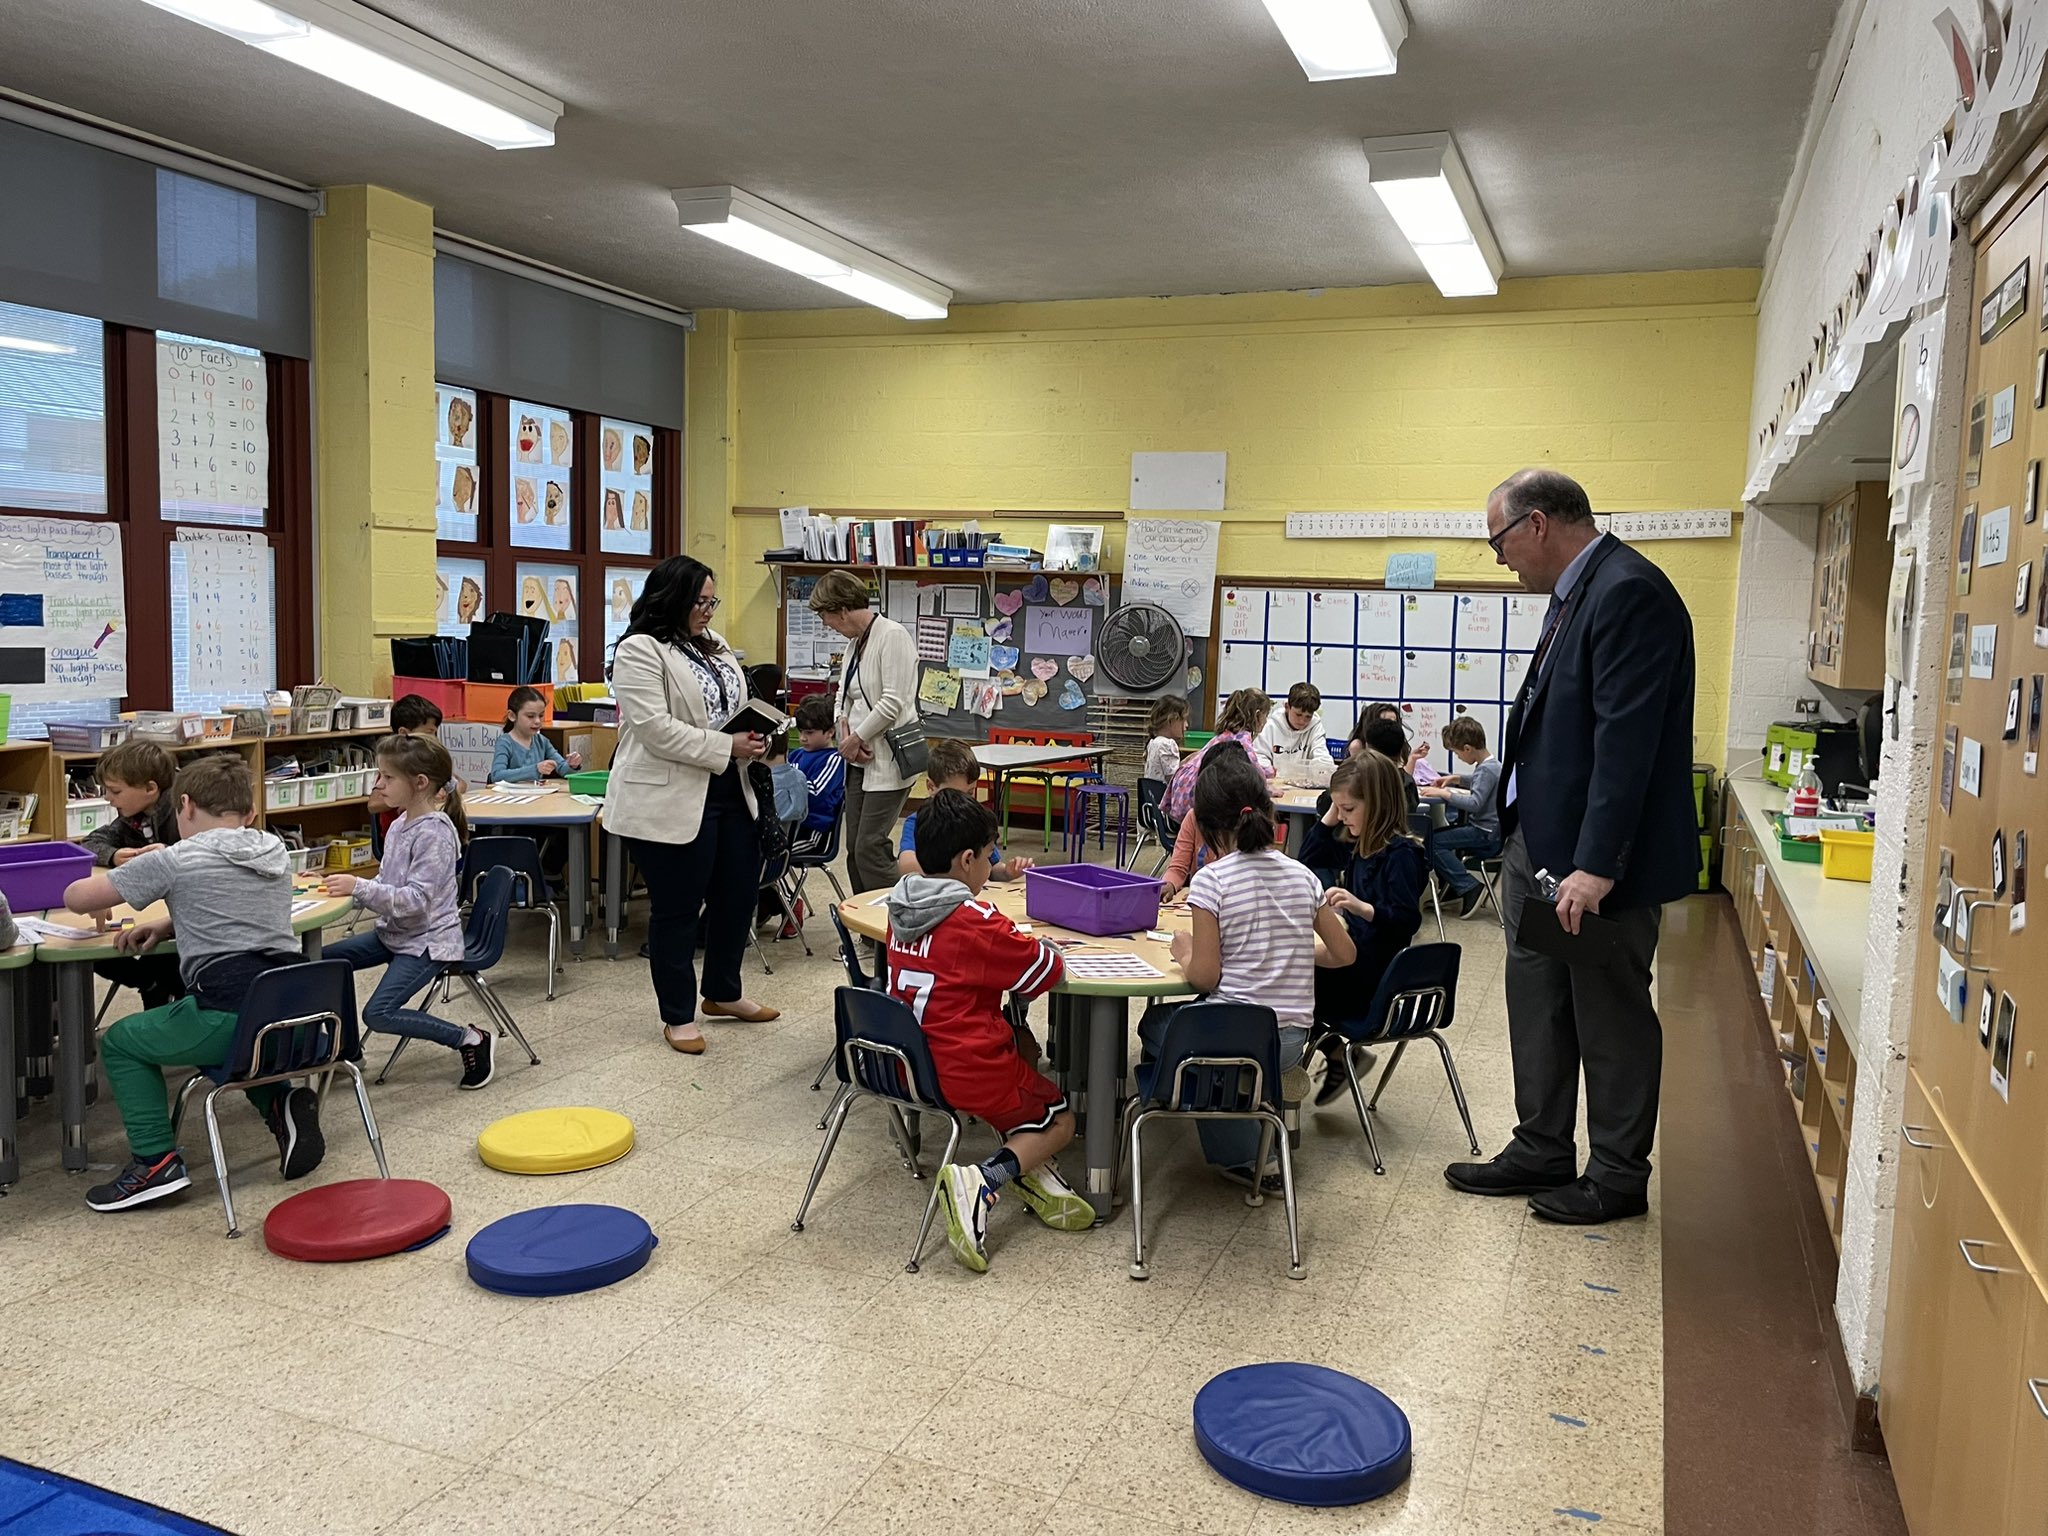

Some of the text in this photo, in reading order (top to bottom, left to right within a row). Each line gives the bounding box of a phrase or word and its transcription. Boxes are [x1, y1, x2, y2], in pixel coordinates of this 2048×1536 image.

[201, 351, 233, 367] Facts
[168, 367, 253, 391] 0 10 10
[173, 386, 255, 411] 1 9 10
[170, 409, 255, 431] 2 8 10
[172, 429, 256, 454] 3 7 10
[171, 452, 255, 475] 4 6 10
[175, 479, 258, 499] 5 5 10
[43, 546, 102, 561] Transparent
[1154, 554, 1177, 563] voice
[64, 561, 73, 571] of
[76, 561, 87, 570] the
[90, 562, 108, 574] light
[1396, 558, 1419, 570] Word
[44, 571, 108, 584] passes through
[1397, 570, 1418, 583] Wall
[46, 594, 111, 606] Translucent
[193, 592, 257, 603] 4 4 8
[95, 609, 122, 620] passes
[49, 618, 83, 632] through
[1233, 620, 1245, 628] all
[1232, 628, 1248, 638] any
[196, 644, 258, 659] 8 8 16
[1373, 652, 1385, 663] my
[70, 664, 89, 677] light
[93, 664, 124, 675] passes
[57, 674, 96, 686] through
[443, 725, 464, 748] How
[466, 727, 476, 747] To
[469, 756, 489, 773] books
[86, 815, 92, 824] D
[889, 934, 933, 959] ALLEN
